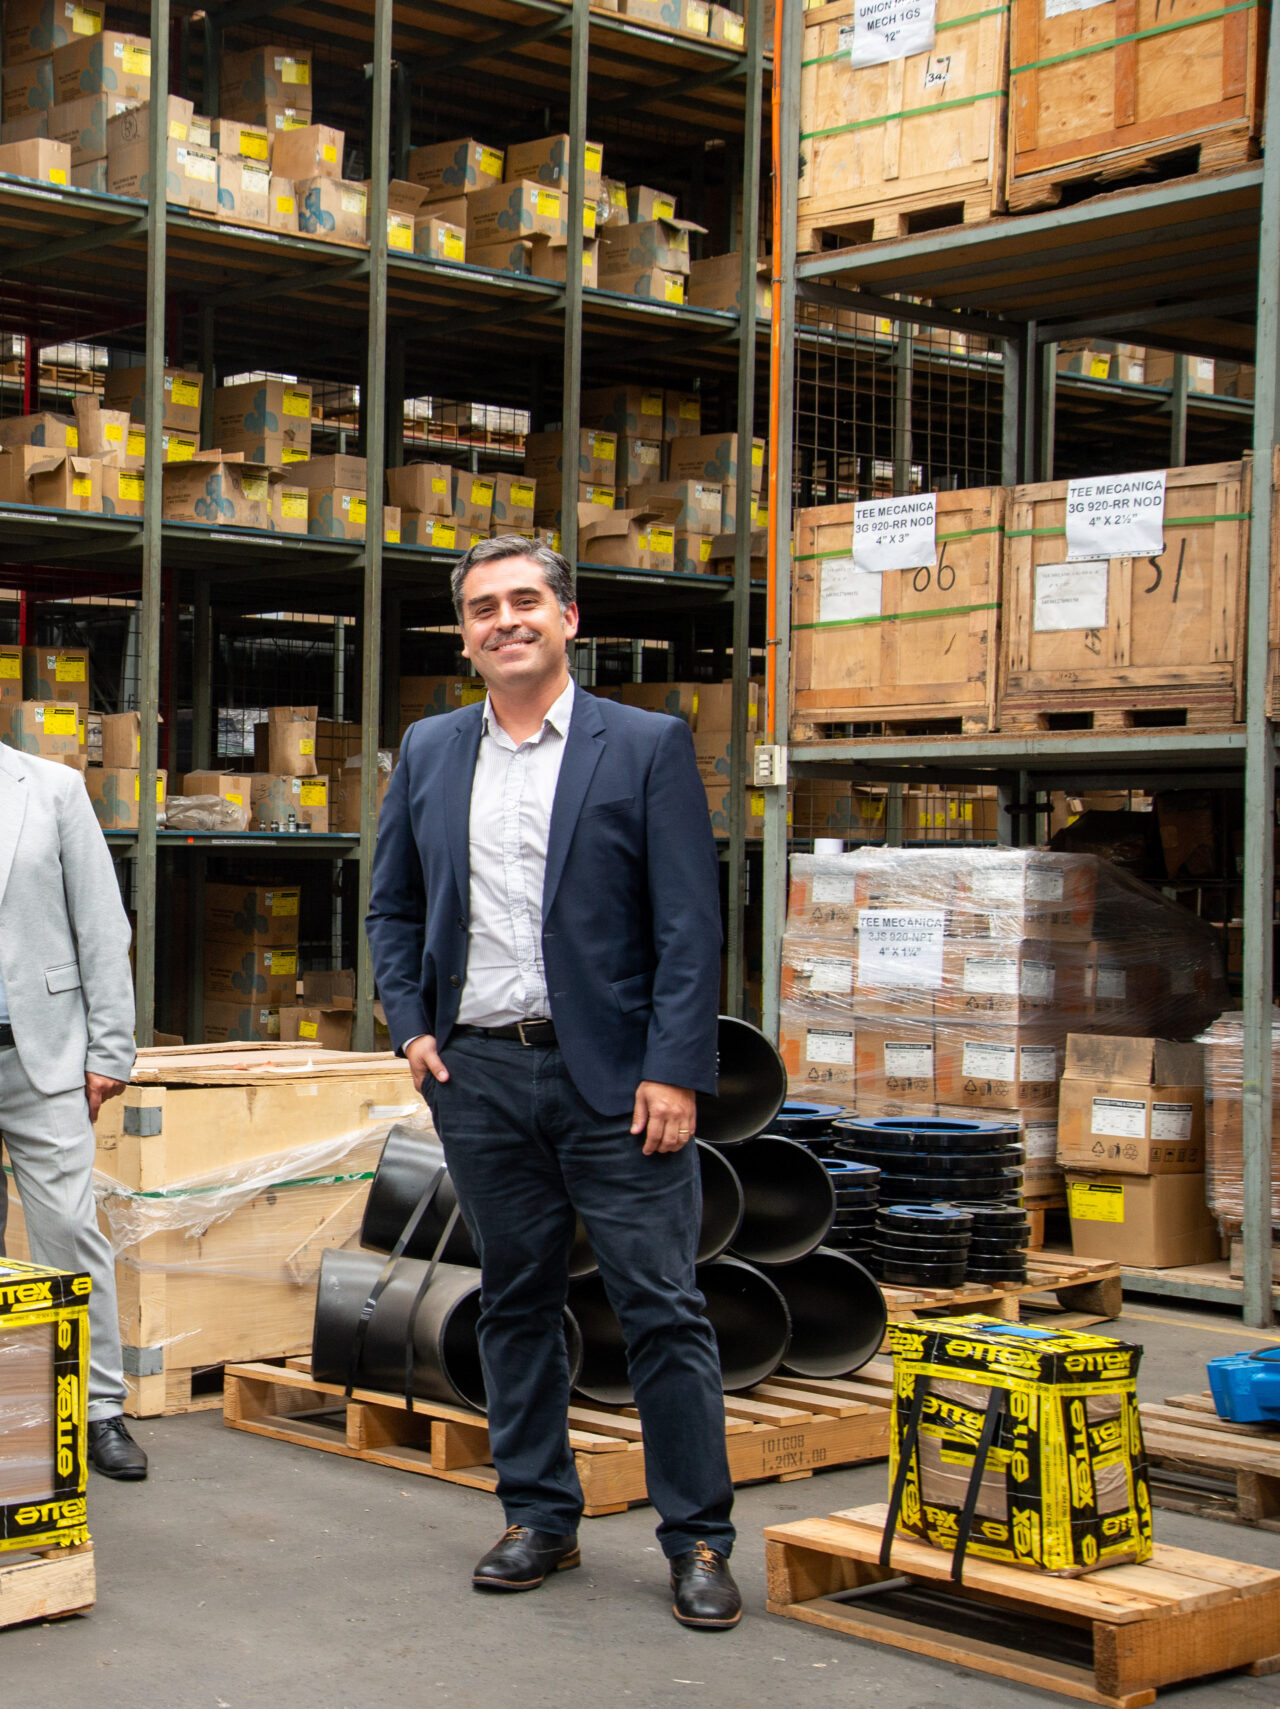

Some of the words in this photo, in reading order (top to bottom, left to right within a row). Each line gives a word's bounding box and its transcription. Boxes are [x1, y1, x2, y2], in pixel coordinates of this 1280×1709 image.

[860, 1, 891, 17] UNION
[867, 14, 896, 31] MECH
[900, 8, 920, 21] 1GS
[885, 30, 901, 42] 12"
[1070, 486, 1093, 498] TEE
[1096, 480, 1163, 496] MECANICA
[856, 508, 876, 519] TEE
[877, 501, 934, 517] MECANICA
[1068, 503, 1085, 513] 3G
[1088, 499, 1130, 512] 920-RR
[1134, 496, 1162, 507] NOD
[855, 524, 869, 533] 3G
[872, 519, 907, 531] 920-RR
[910, 516, 934, 527] NOD
[1104, 516, 1111, 525] X
[889, 535, 896, 543] X
[860, 917, 880, 927] TEE
[882, 917, 942, 928] MECANICA
